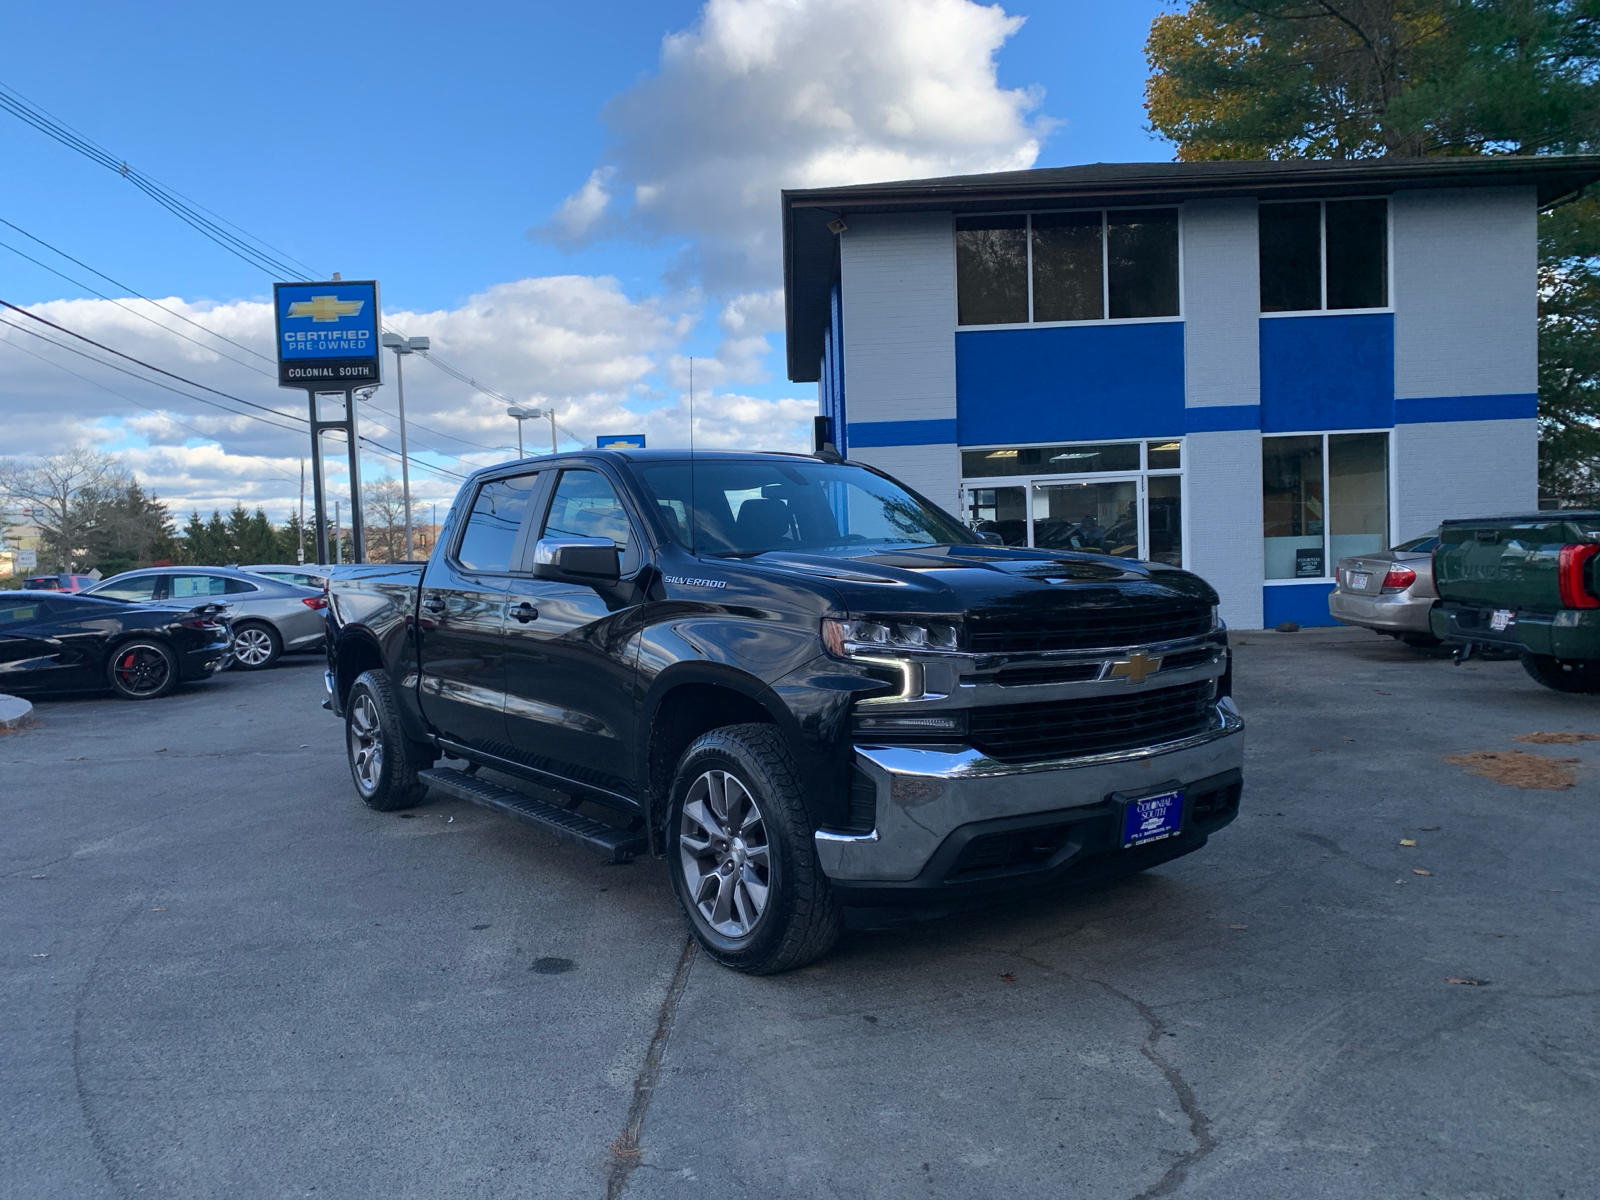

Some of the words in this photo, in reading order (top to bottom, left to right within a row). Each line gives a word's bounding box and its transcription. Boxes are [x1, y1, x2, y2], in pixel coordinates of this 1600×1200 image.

[284, 330, 369, 341] CERTIFIED
[289, 340, 366, 350] PRE-OWNED
[288, 367, 334, 378] COLONIAL
[339, 366, 369, 376] SOUTH
[665, 575, 727, 589] SILVERADO
[694, 747, 740, 766] KUMHO
[1137, 798, 1173, 812] COLONIAL
[1141, 807, 1167, 820] SOUTH
